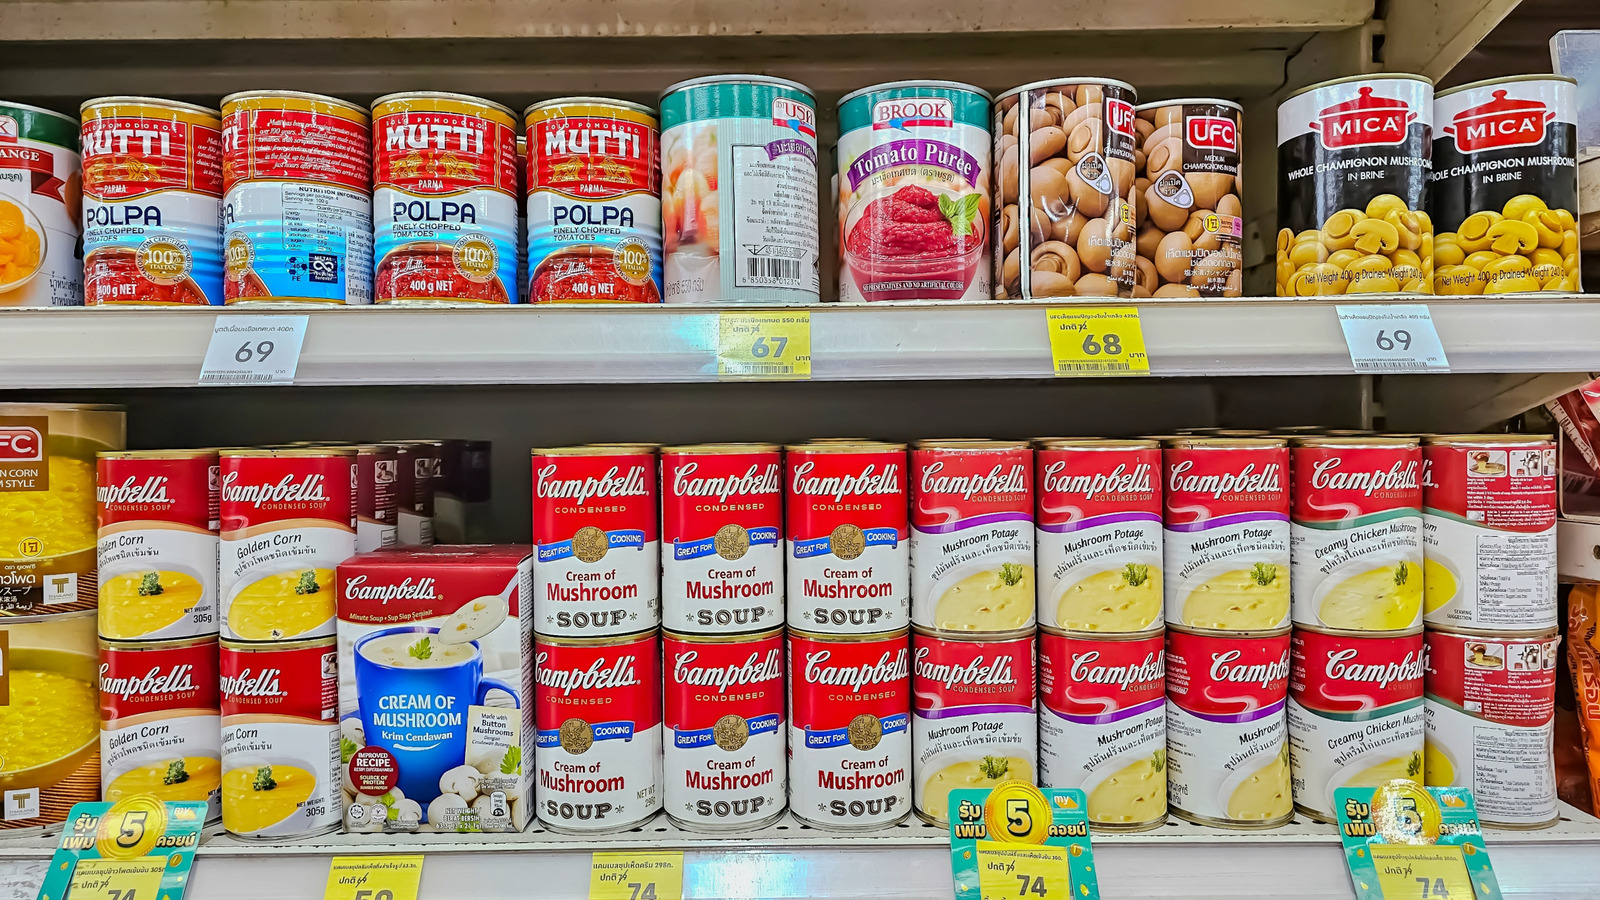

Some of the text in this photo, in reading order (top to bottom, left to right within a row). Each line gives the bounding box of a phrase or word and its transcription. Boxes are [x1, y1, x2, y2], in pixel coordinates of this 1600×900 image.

[879, 103, 948, 121] BROOK
[1332, 116, 1399, 137] MICA
[1467, 118, 1535, 141] MICA
[82, 130, 170, 159] MUTTI
[386, 124, 484, 154] MUTTI
[545, 129, 640, 159] MUTTI
[854, 142, 972, 178] Tomato Puree
[1183, 162, 1222, 171] CHAMPIGNONS
[1204, 154, 1225, 163] MEDIUM
[1288, 156, 1387, 181] WHOLE CHAMPIGNON
[1450, 156, 1575, 177] CHAMPIGNON MUSHROOMS
[418, 180, 444, 189] PARMA
[1347, 170, 1385, 181] IN BRINE
[1483, 171, 1522, 183] IN BRINE
[580, 184, 604, 193] PARMA
[87, 206, 161, 227] POLPA
[393, 201, 476, 224] POLPA
[553, 204, 634, 228] POLPA
[392, 223, 417, 231] FINELY
[581, 227, 621, 235] CHOPPED
[147, 250, 181, 265] 100%
[464, 246, 491, 262] 100%
[624, 250, 647, 264] 100%
[1305, 267, 1419, 284] Net Weight 400 Drained Weight 240
[120, 284, 137, 294] NET
[410, 280, 454, 292] 400 g NET
[572, 283, 614, 294] 400 NET
[752, 337, 788, 357] 67
[1082, 334, 1122, 355] 68
[1376, 330, 1411, 350] 69
[235, 341, 274, 362] 69
[8, 469, 39, 477] CORN
[673, 462, 780, 504] Campbell's
[792, 461, 899, 503] Campbell's
[921, 461, 1026, 502] Campbell's
[1043, 460, 1152, 500] Campbell's
[1311, 457, 1417, 497] Campbell's
[6, 479, 35, 488] STYLE
[222, 471, 326, 510] Campbell's
[536, 464, 646, 506] Campbell's
[110, 504, 149, 512] CONDENSED
[262, 502, 308, 510] CONDENSED
[695, 503, 765, 512] CONDENSED
[1222, 494, 1266, 502] CONDENSED
[555, 505, 627, 514] CONDENSED
[119, 534, 143, 545] Corn
[237, 533, 302, 559] Golden Corn
[539, 534, 641, 559] GREAT FOR COOKING
[941, 528, 1019, 555] Mushroom Potage
[1064, 528, 1144, 555] Mushroom Potage
[1190, 528, 1272, 554] Mushroom Potage
[1314, 524, 1417, 560] Creamy Chicken Mushroom
[566, 569, 616, 582] Cream of
[823, 567, 873, 579] Cream of
[345, 575, 437, 605] Campbell's
[547, 582, 638, 602] Mushroom
[686, 580, 774, 600] Mushroom
[803, 579, 893, 599] Mushroom
[193, 614, 212, 624] 305g
[388, 614, 398, 622] Sup
[399, 612, 411, 620] Siap
[556, 609, 627, 629] SOUP
[697, 606, 766, 626] SOUP
[378, 694, 456, 710] CREAM OF
[373, 713, 462, 728] MUSHROOM
[482, 719, 507, 729] Button
[109, 724, 169, 749] Golden Corn
[382, 731, 452, 742] Krim Cendawan
[473, 727, 514, 737] Mushrooms
[595, 726, 630, 737] COOKING
[927, 721, 1004, 741] Mushroom Potage
[1097, 723, 1144, 747] Mushroom
[1328, 719, 1401, 750] Creamy Chicken
[356, 758, 390, 767] RECIPE
[706, 756, 756, 770] Cream of
[540, 768, 625, 794] Mushroom
[1054, 795, 1069, 804] my
[306, 806, 325, 818] 305g
[547, 800, 613, 820] SOUP
[954, 799, 1087, 838] เพิ่ม 5 คอยน์
[959, 801, 981, 821] รับ
[62, 810, 196, 850] เพิ่ม 5 คอยน์
[74, 813, 97, 832] รับ
[988, 862, 1004, 870] ปกติ
[600, 873, 617, 881] ปกติ
[1017, 874, 1047, 897] 74
[628, 883, 657, 900] 74
